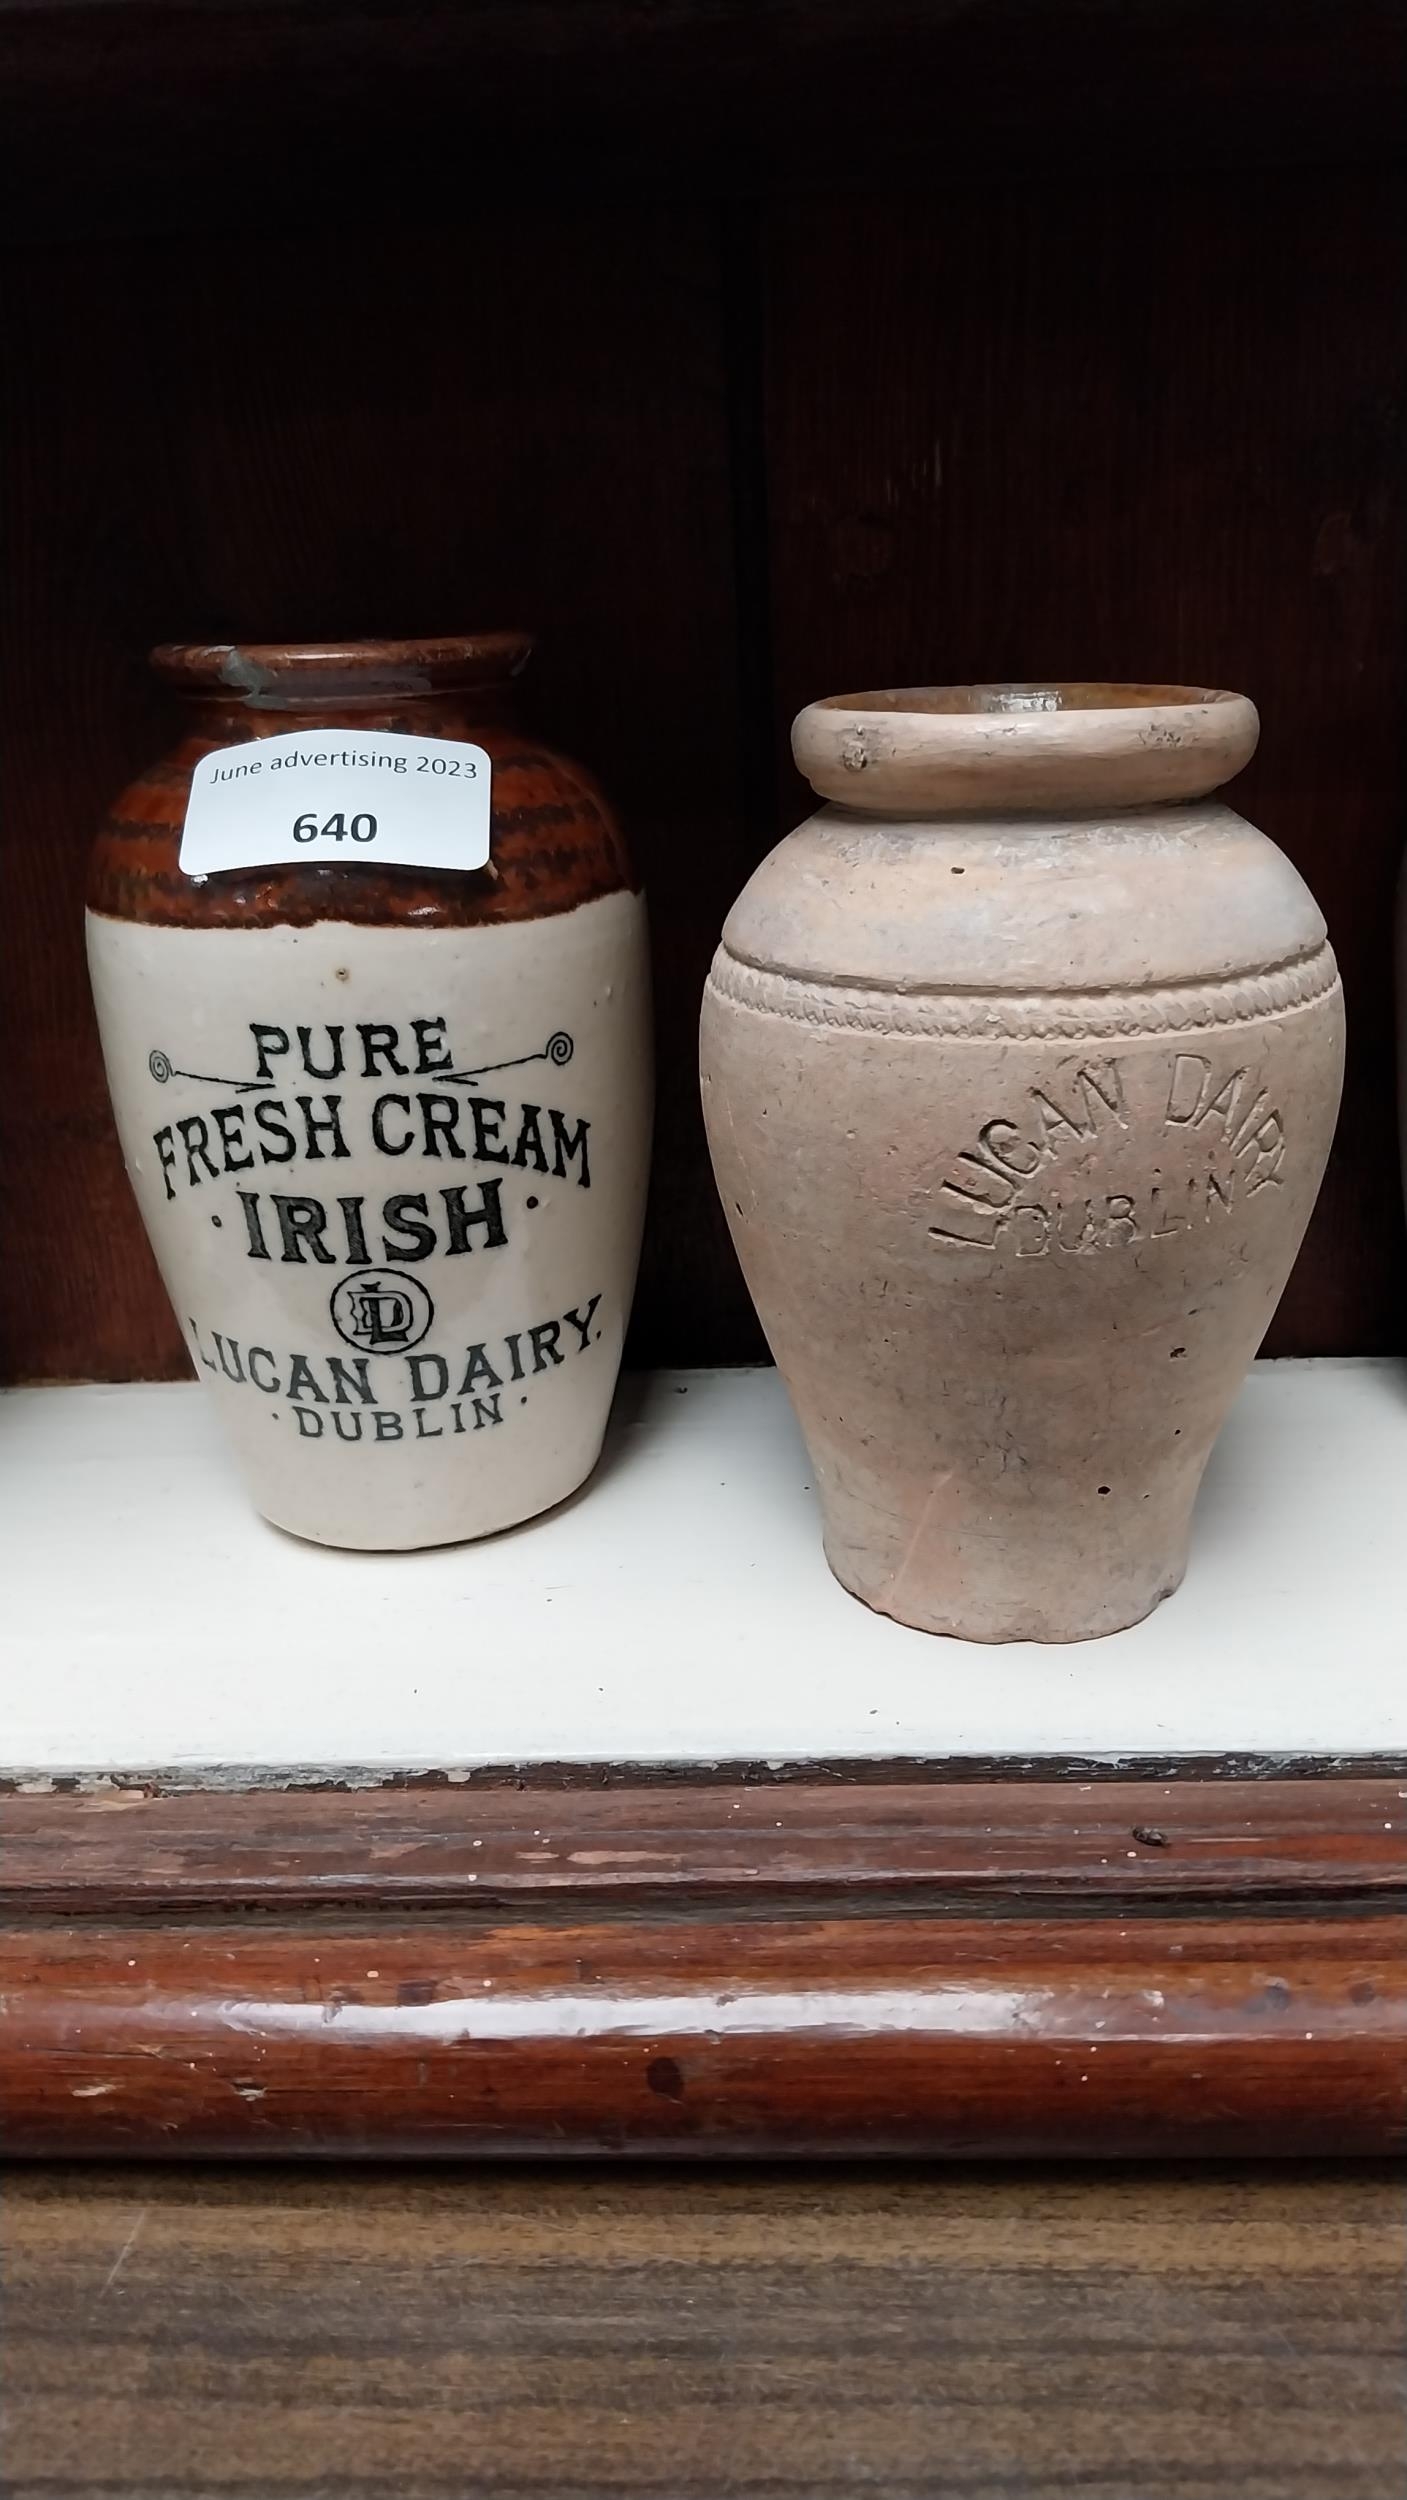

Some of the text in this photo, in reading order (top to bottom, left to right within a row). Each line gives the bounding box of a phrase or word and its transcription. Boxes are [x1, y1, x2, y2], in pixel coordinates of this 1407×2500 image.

[209, 751, 478, 784] June advertising 2023
[292, 813, 377, 843] 640
[249, 1016, 454, 1079] PURE
[152, 1092, 592, 1200] FRESH CREAM
[927, 1052, 1286, 1251] LUCAN DAIRY
[236, 1177, 509, 1265] IRISH
[1012, 1170, 1235, 1257] DUBLIN
[188, 1316, 379, 1405] LUCAN
[291, 1392, 504, 1442] DUBLIN
